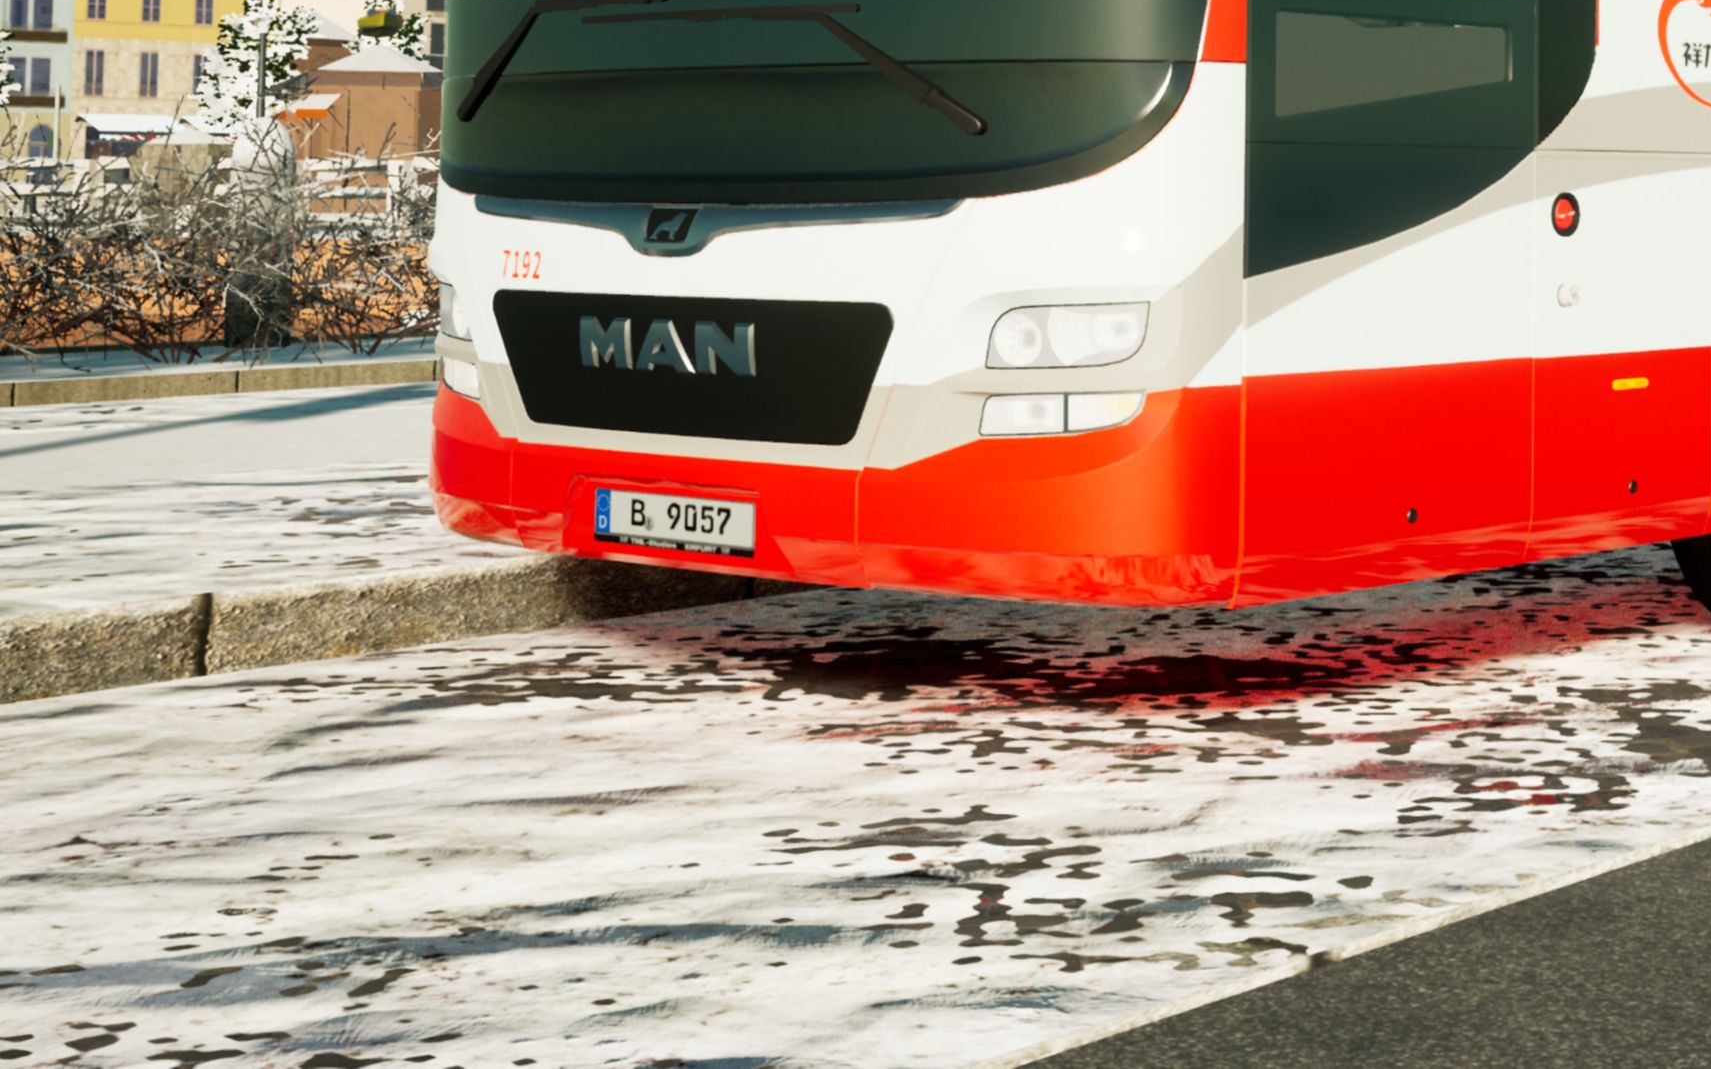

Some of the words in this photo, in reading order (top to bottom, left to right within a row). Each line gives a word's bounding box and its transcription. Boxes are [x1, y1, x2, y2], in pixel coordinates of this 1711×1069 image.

[502, 249, 542, 280] 7192
[579, 315, 757, 377] MAN
[631, 498, 646, 527] B
[667, 502, 732, 535] 9057
